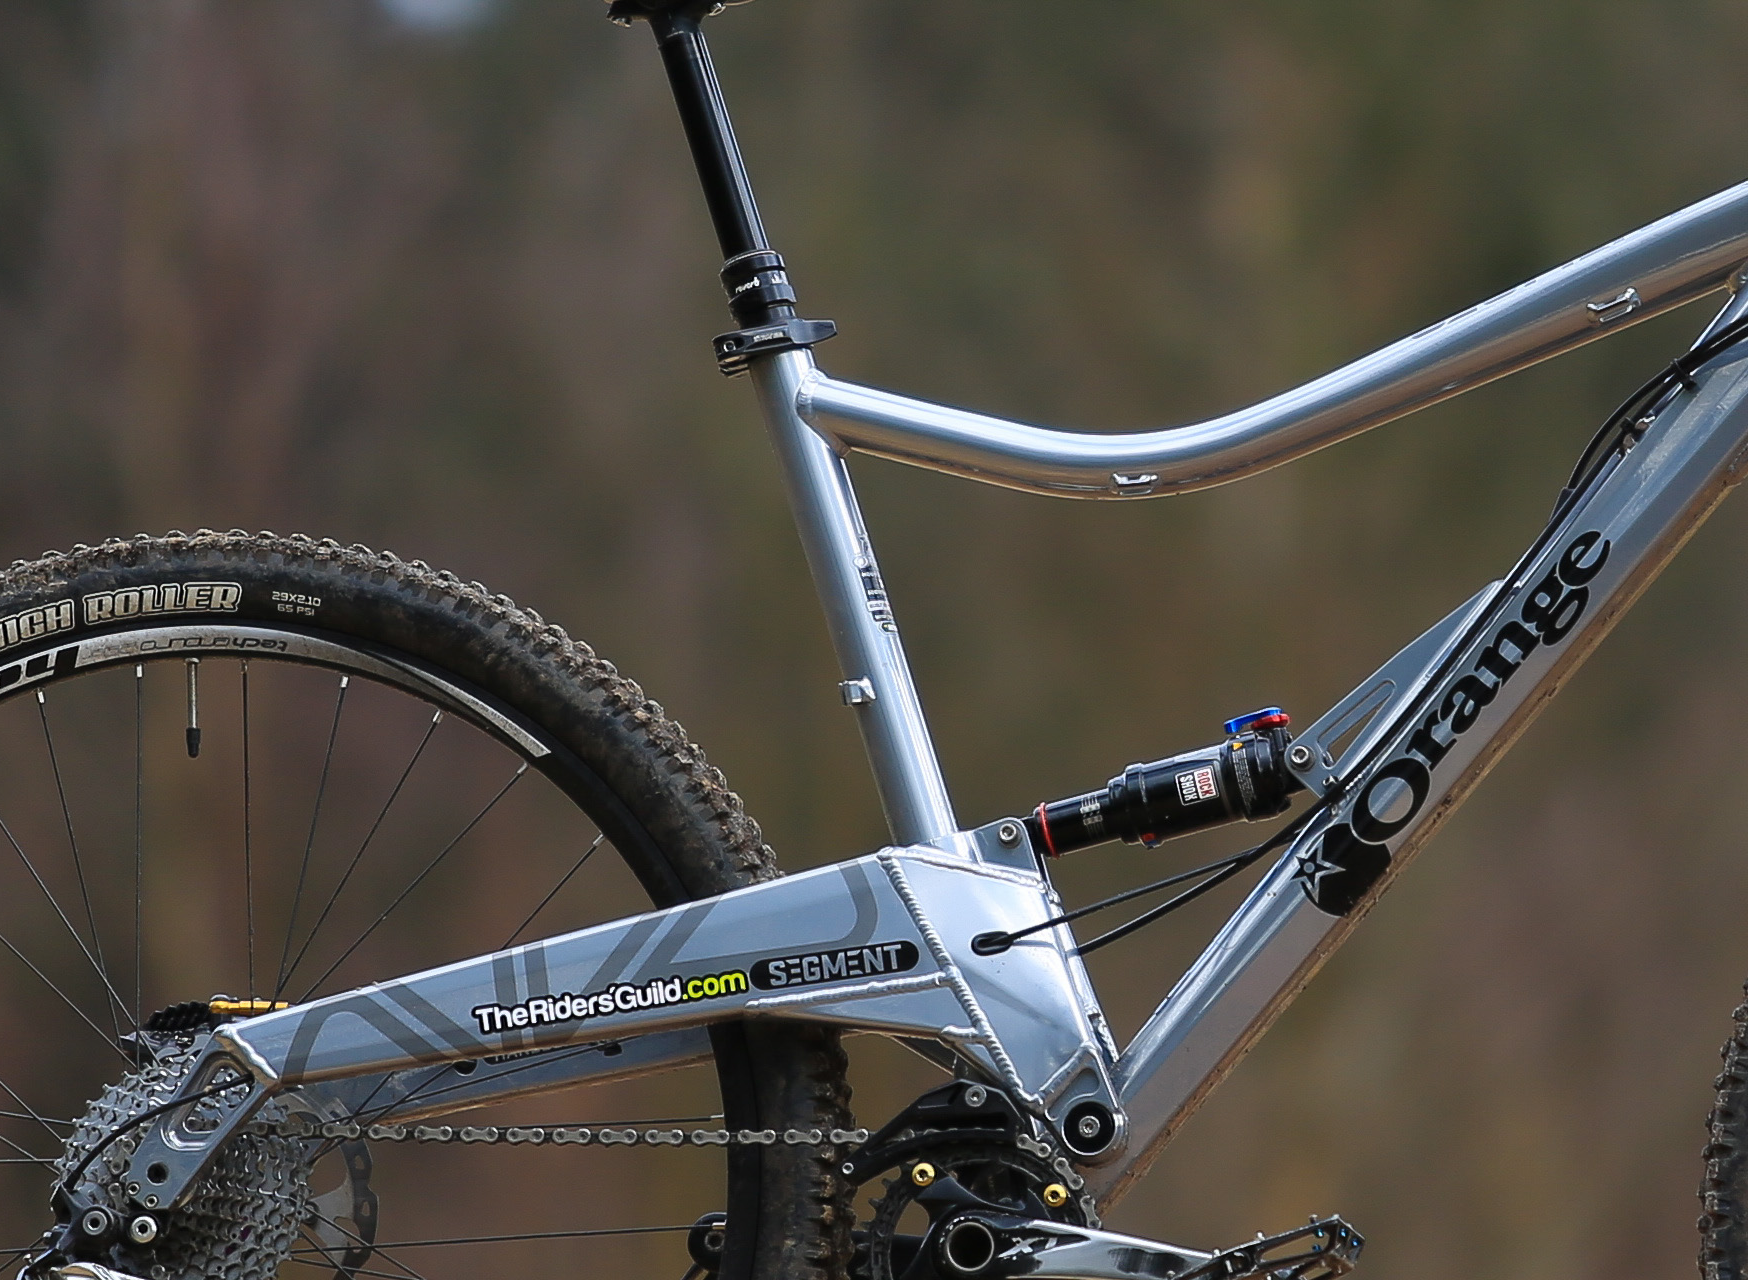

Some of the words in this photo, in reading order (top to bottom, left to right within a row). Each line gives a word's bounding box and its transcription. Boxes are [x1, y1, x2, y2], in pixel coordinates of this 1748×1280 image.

[82, 582, 242, 625] ROLLER
[271, 590, 321, 608] 29X2.10
[277, 603, 294, 614] 65
[296, 606, 315, 616] PSI
[1352, 530, 1611, 845] Orange
[1180, 773, 1197, 802] SHOX
[1196, 767, 1215, 800] ROCK
[769, 944, 902, 987] SEGMENT
